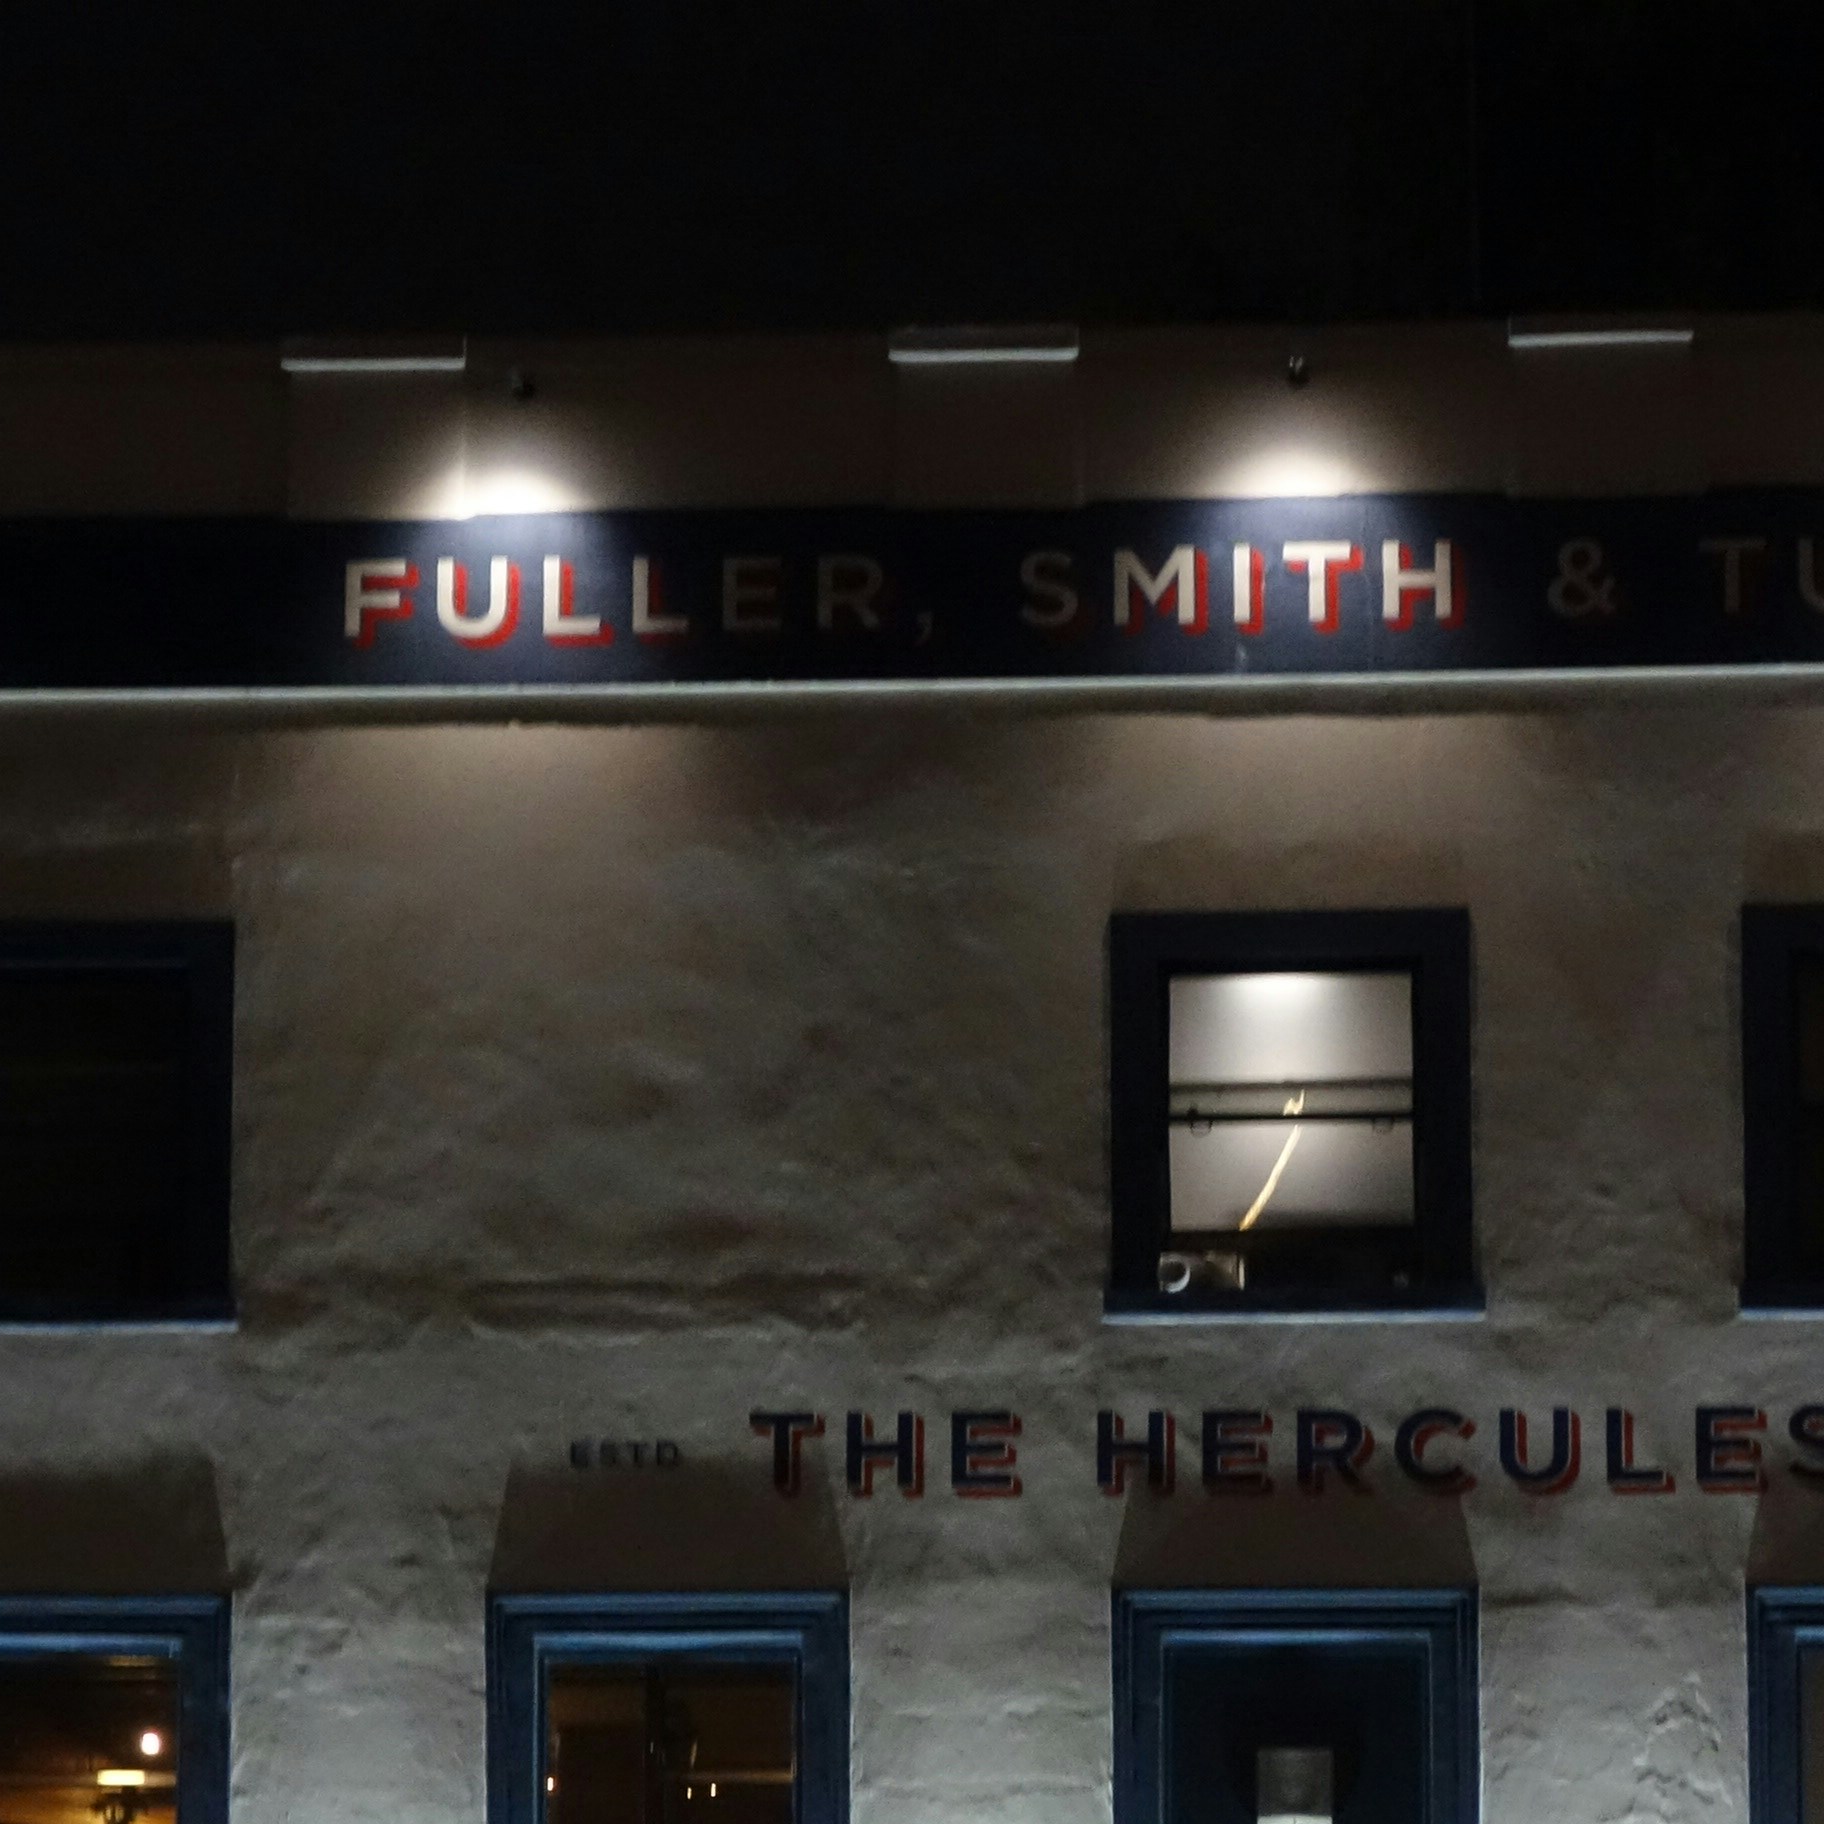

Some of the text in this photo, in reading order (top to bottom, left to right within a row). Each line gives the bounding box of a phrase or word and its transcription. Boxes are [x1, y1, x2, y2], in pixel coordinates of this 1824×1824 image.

[342, 553, 940, 648] FULLER,
[1017, 537, 1465, 640] SMITH
[1547, 535, 1629, 619] &
[749, 1409, 1023, 1499] THE
